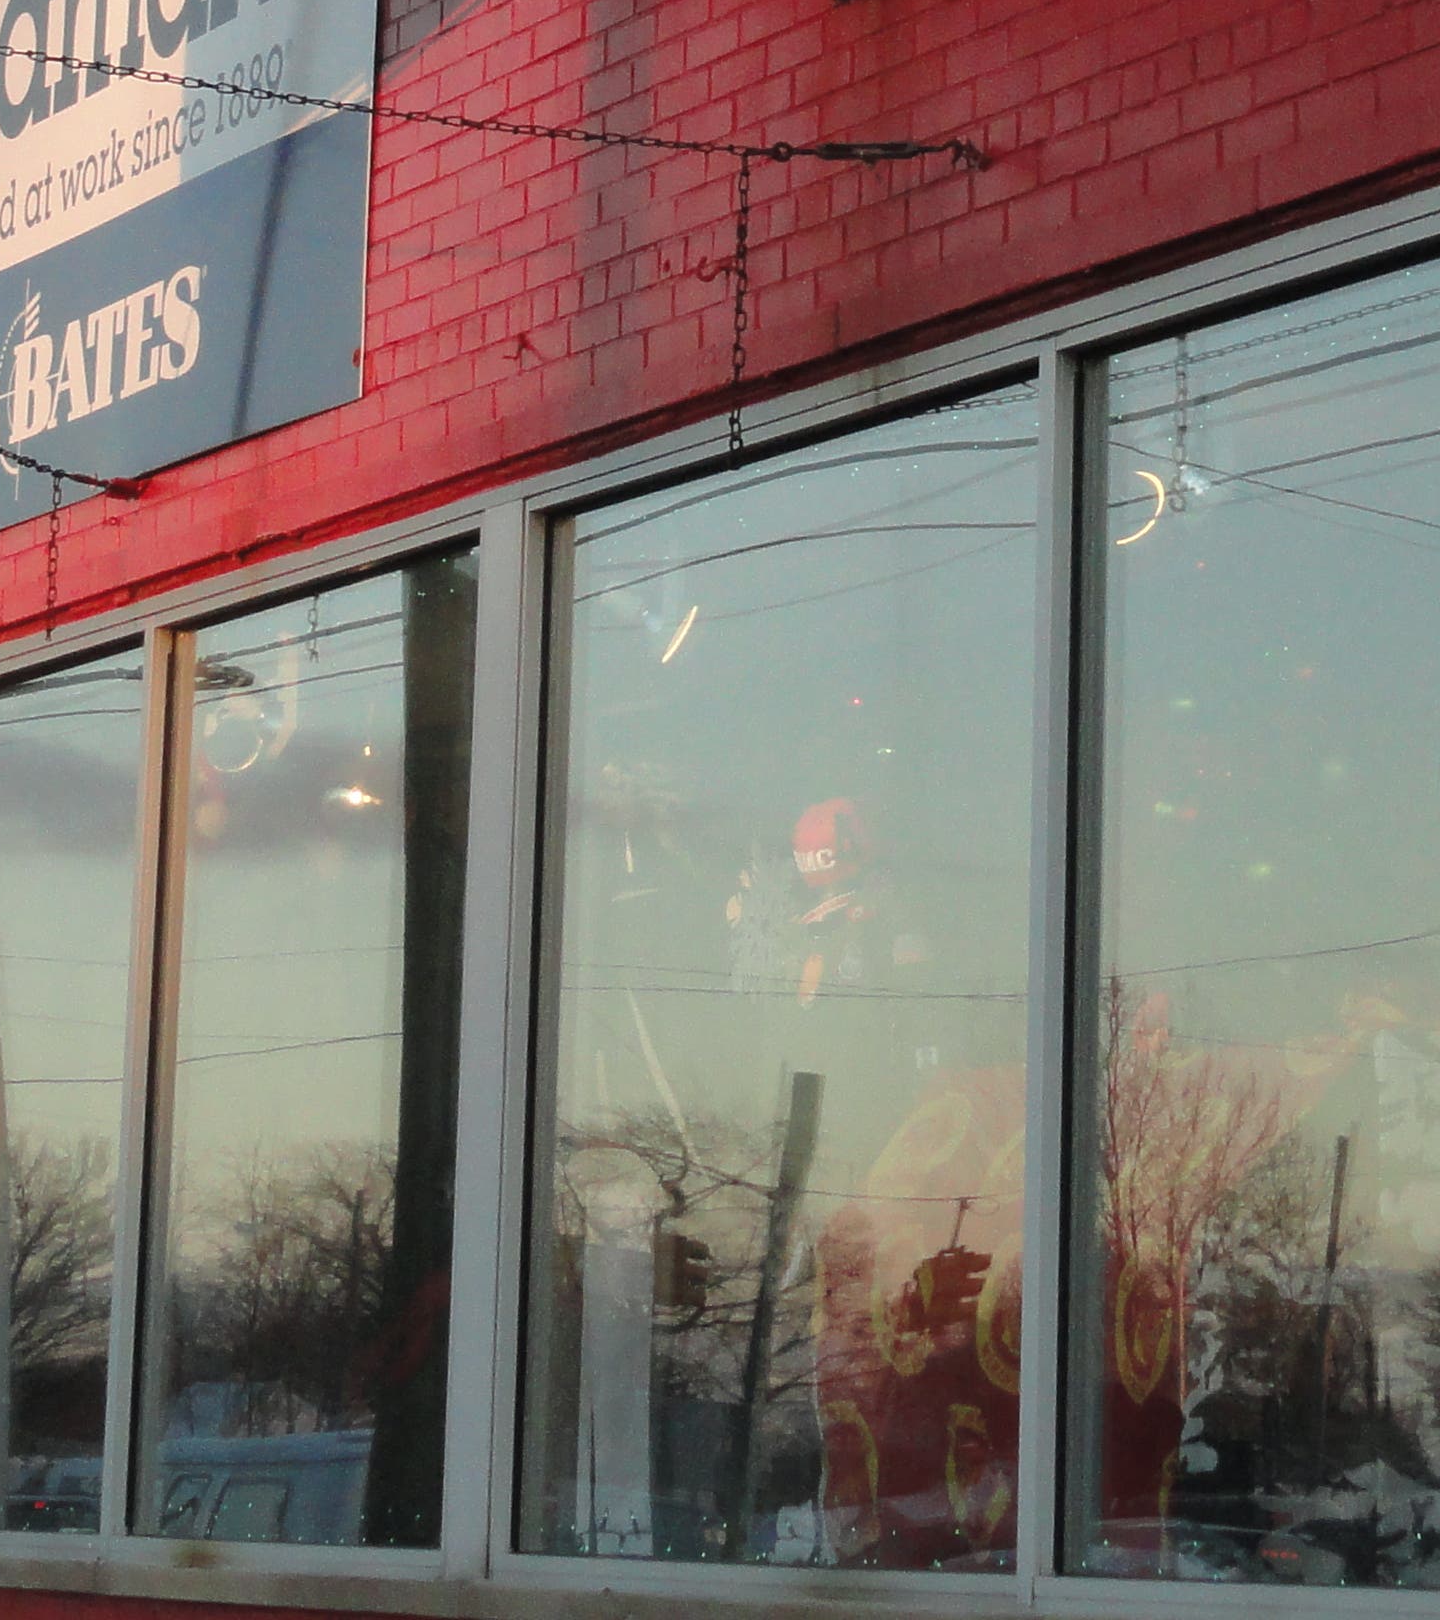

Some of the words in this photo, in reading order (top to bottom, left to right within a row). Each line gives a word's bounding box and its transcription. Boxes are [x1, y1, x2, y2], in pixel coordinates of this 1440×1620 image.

[24, 160, 57, 228] at
[59, 134, 126, 212] work
[130, 104, 205, 178] since
[213, 49, 285, 136] 1889
[8, 265, 203, 446] BATES
